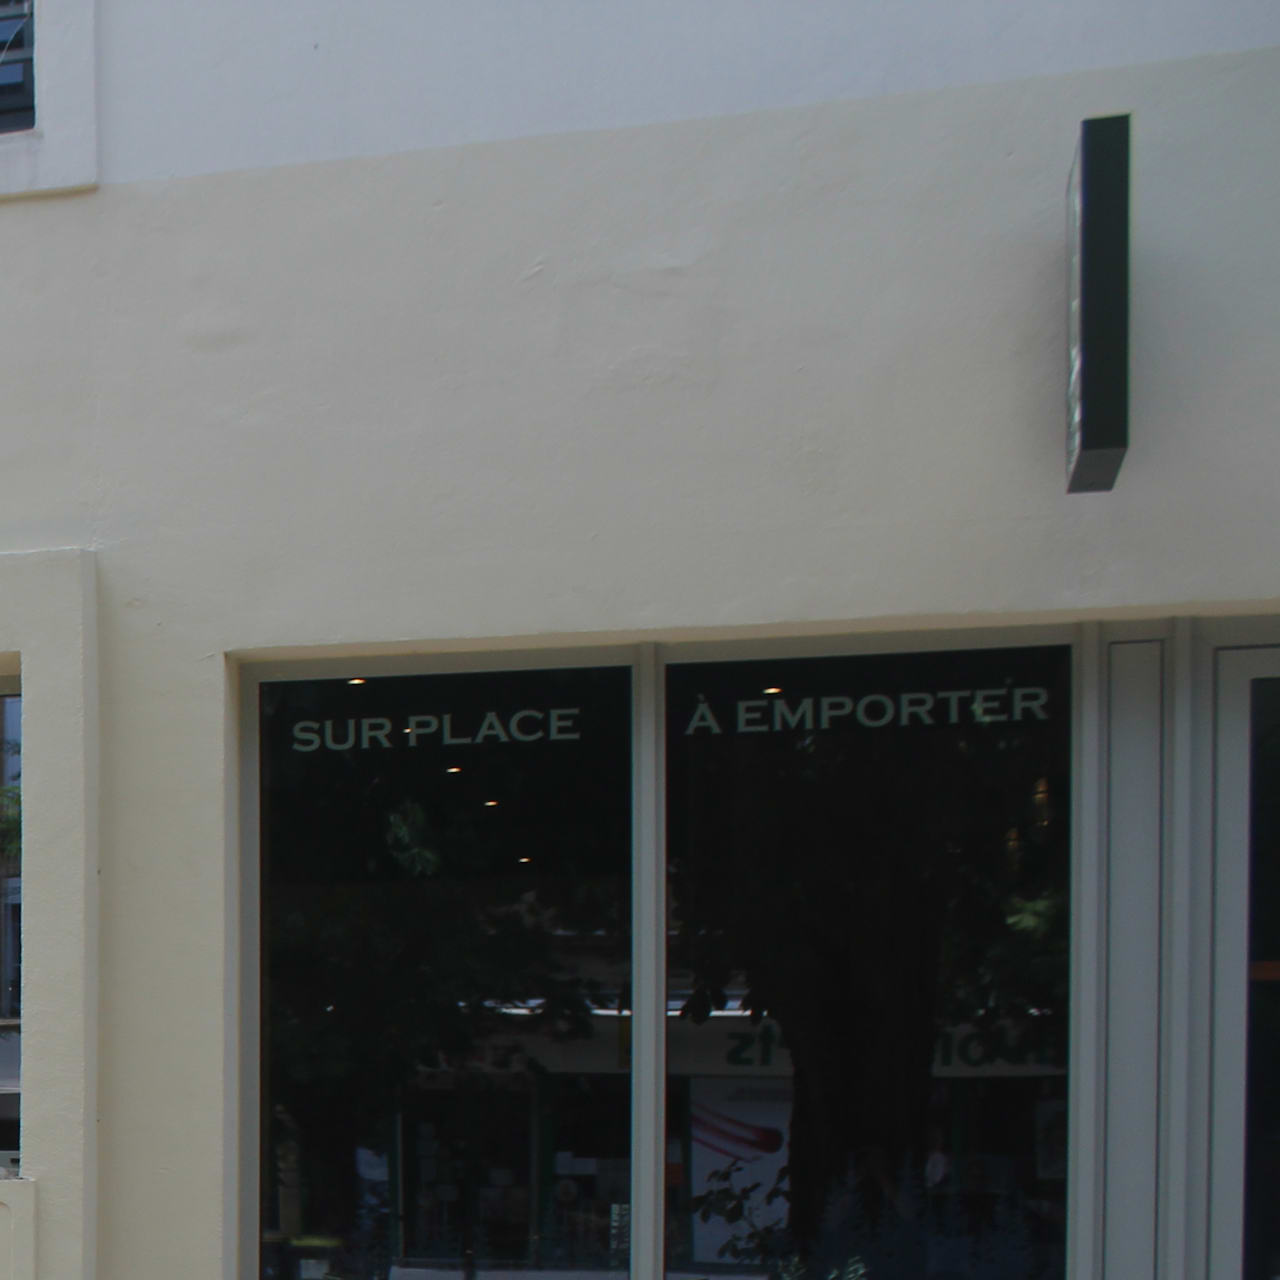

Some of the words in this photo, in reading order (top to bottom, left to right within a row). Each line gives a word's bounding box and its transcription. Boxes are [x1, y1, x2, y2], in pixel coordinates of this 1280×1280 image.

[292, 717, 392, 751] SUR
[408, 708, 580, 747] PLACE
[736, 687, 1050, 733] EMPORTER
